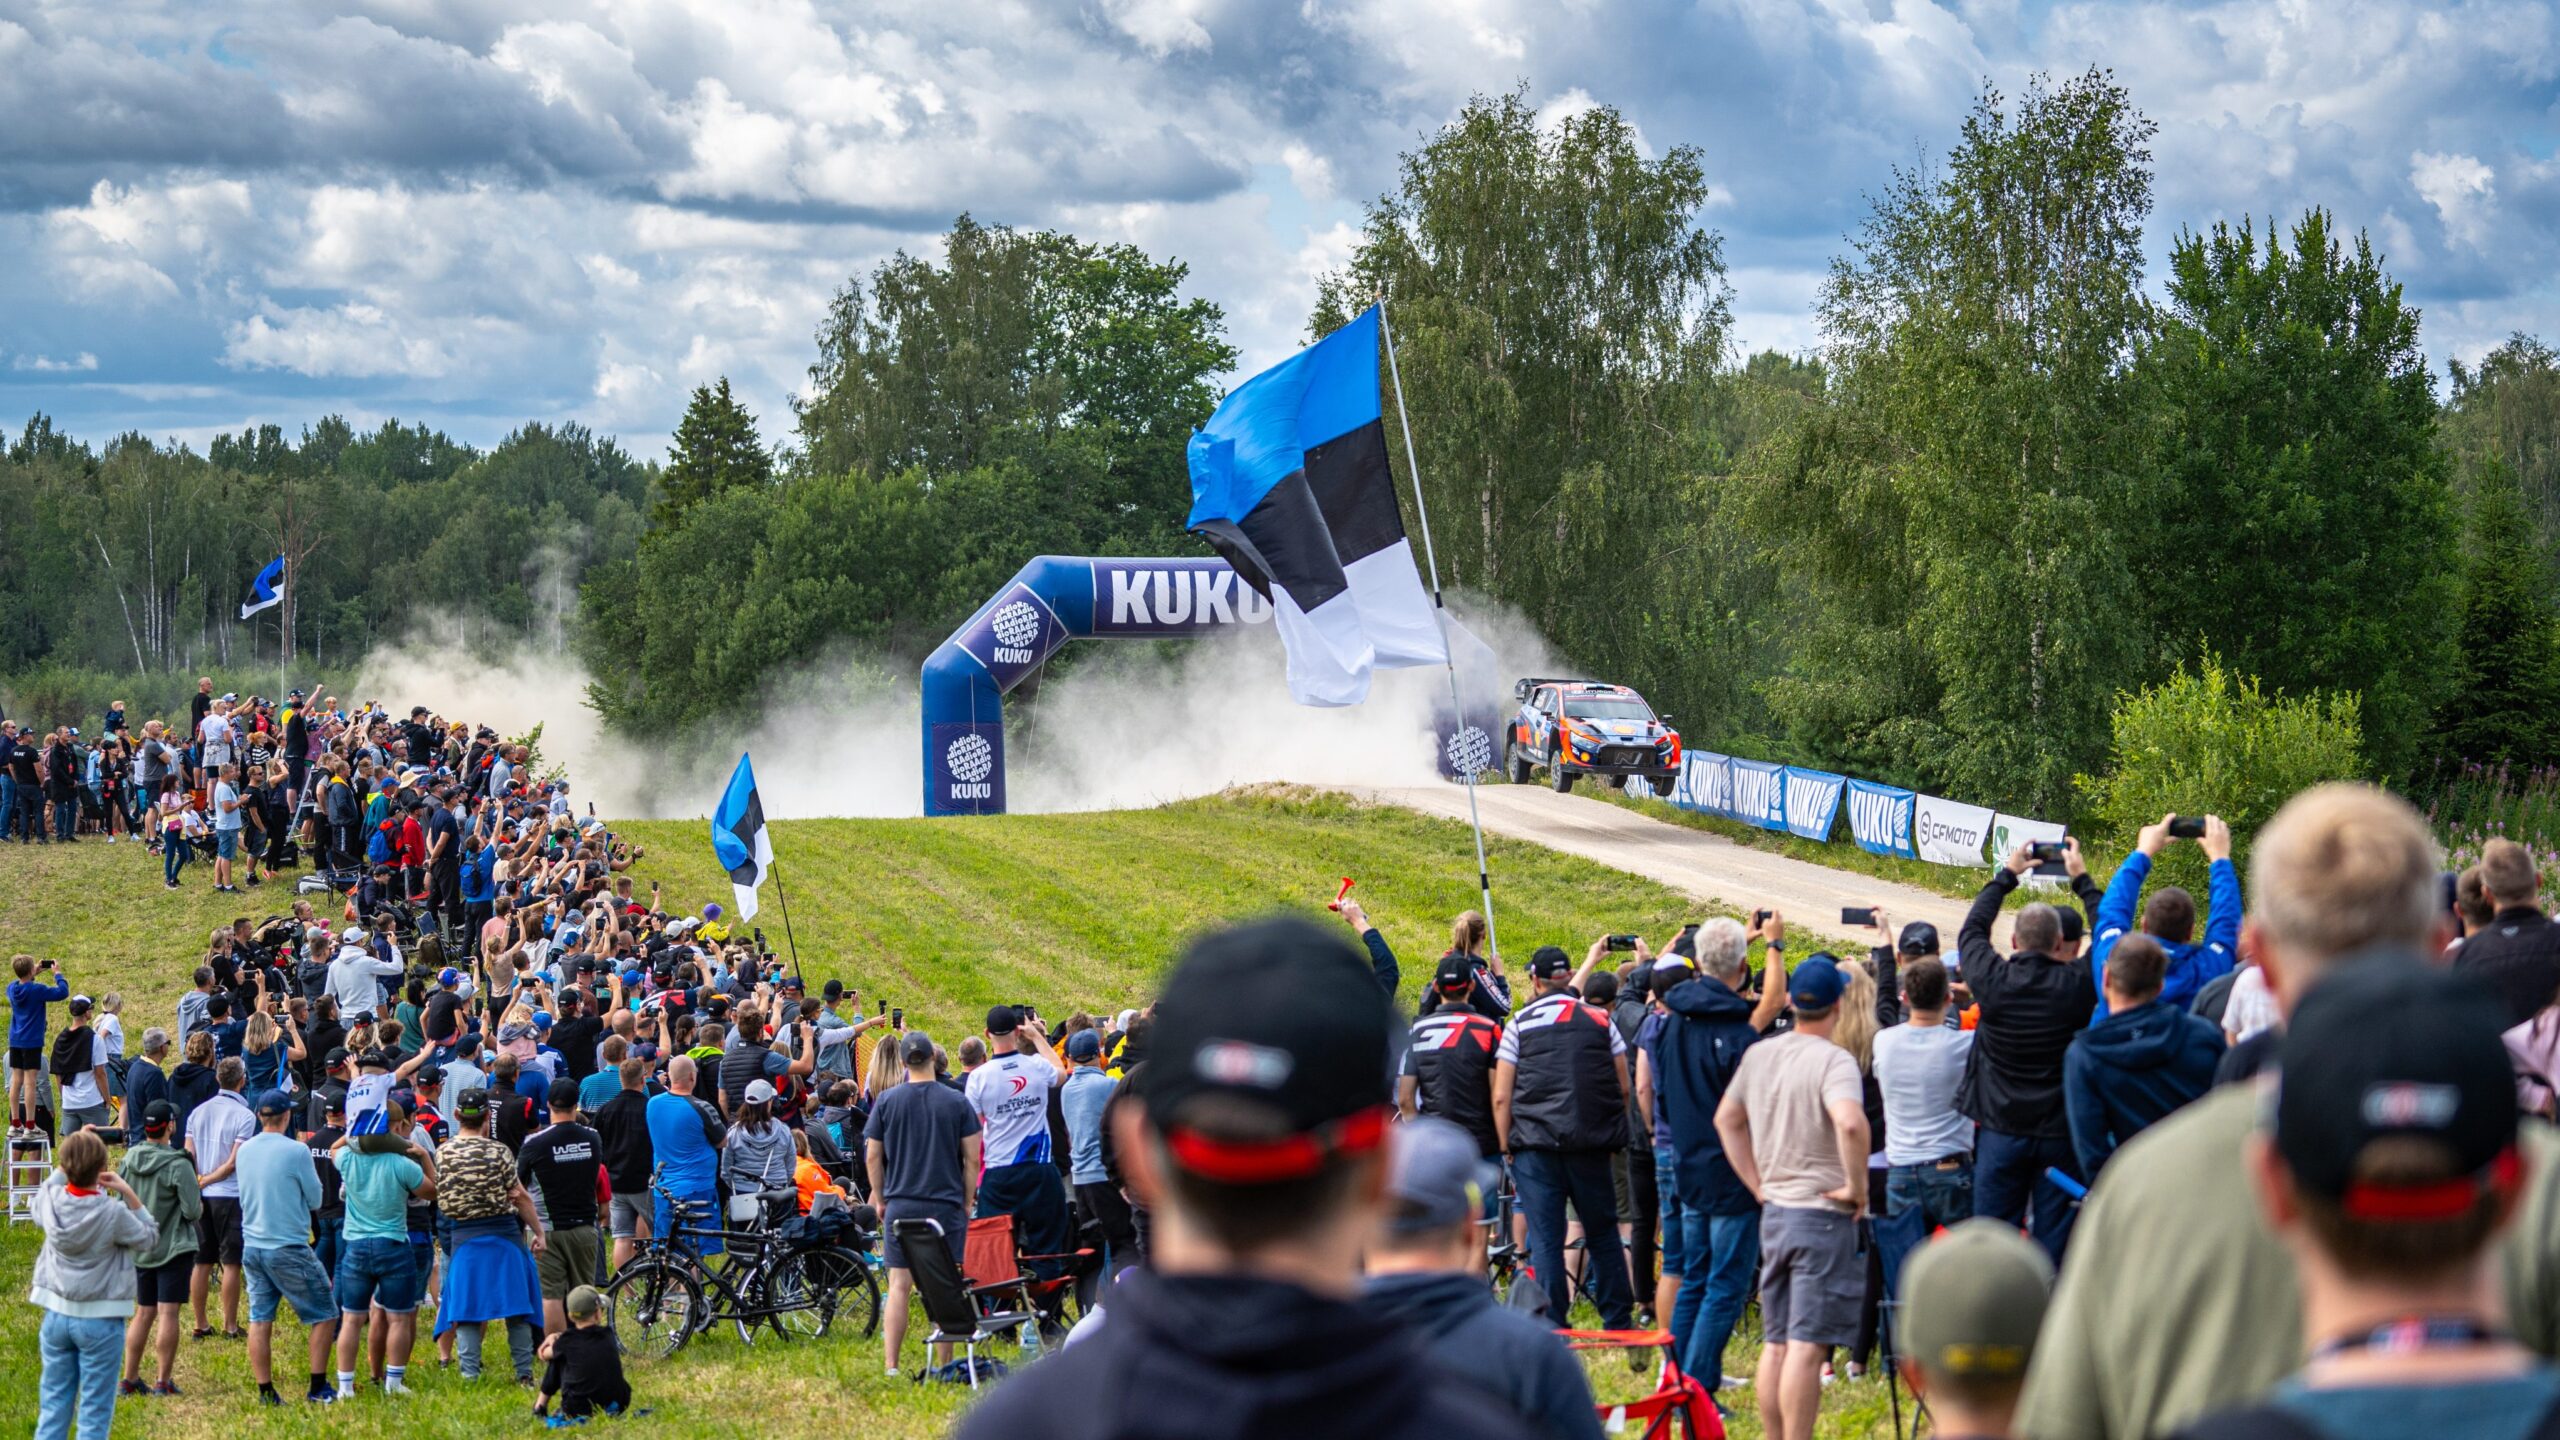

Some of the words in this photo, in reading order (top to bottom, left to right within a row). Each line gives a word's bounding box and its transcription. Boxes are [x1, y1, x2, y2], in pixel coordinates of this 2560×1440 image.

[1111, 570, 1274, 624] KUKU
[993, 647, 1033, 664] KUKU
[951, 783, 991, 799] KUKU
[1690, 759, 1721, 809] KUKU
[1734, 767, 1770, 819] KUKU
[1786, 775, 1827, 829] KUKU
[1850, 789, 1895, 847] KUKU
[1932, 822, 1977, 847] CFMOTO
[552, 1141, 592, 1155] WRC
